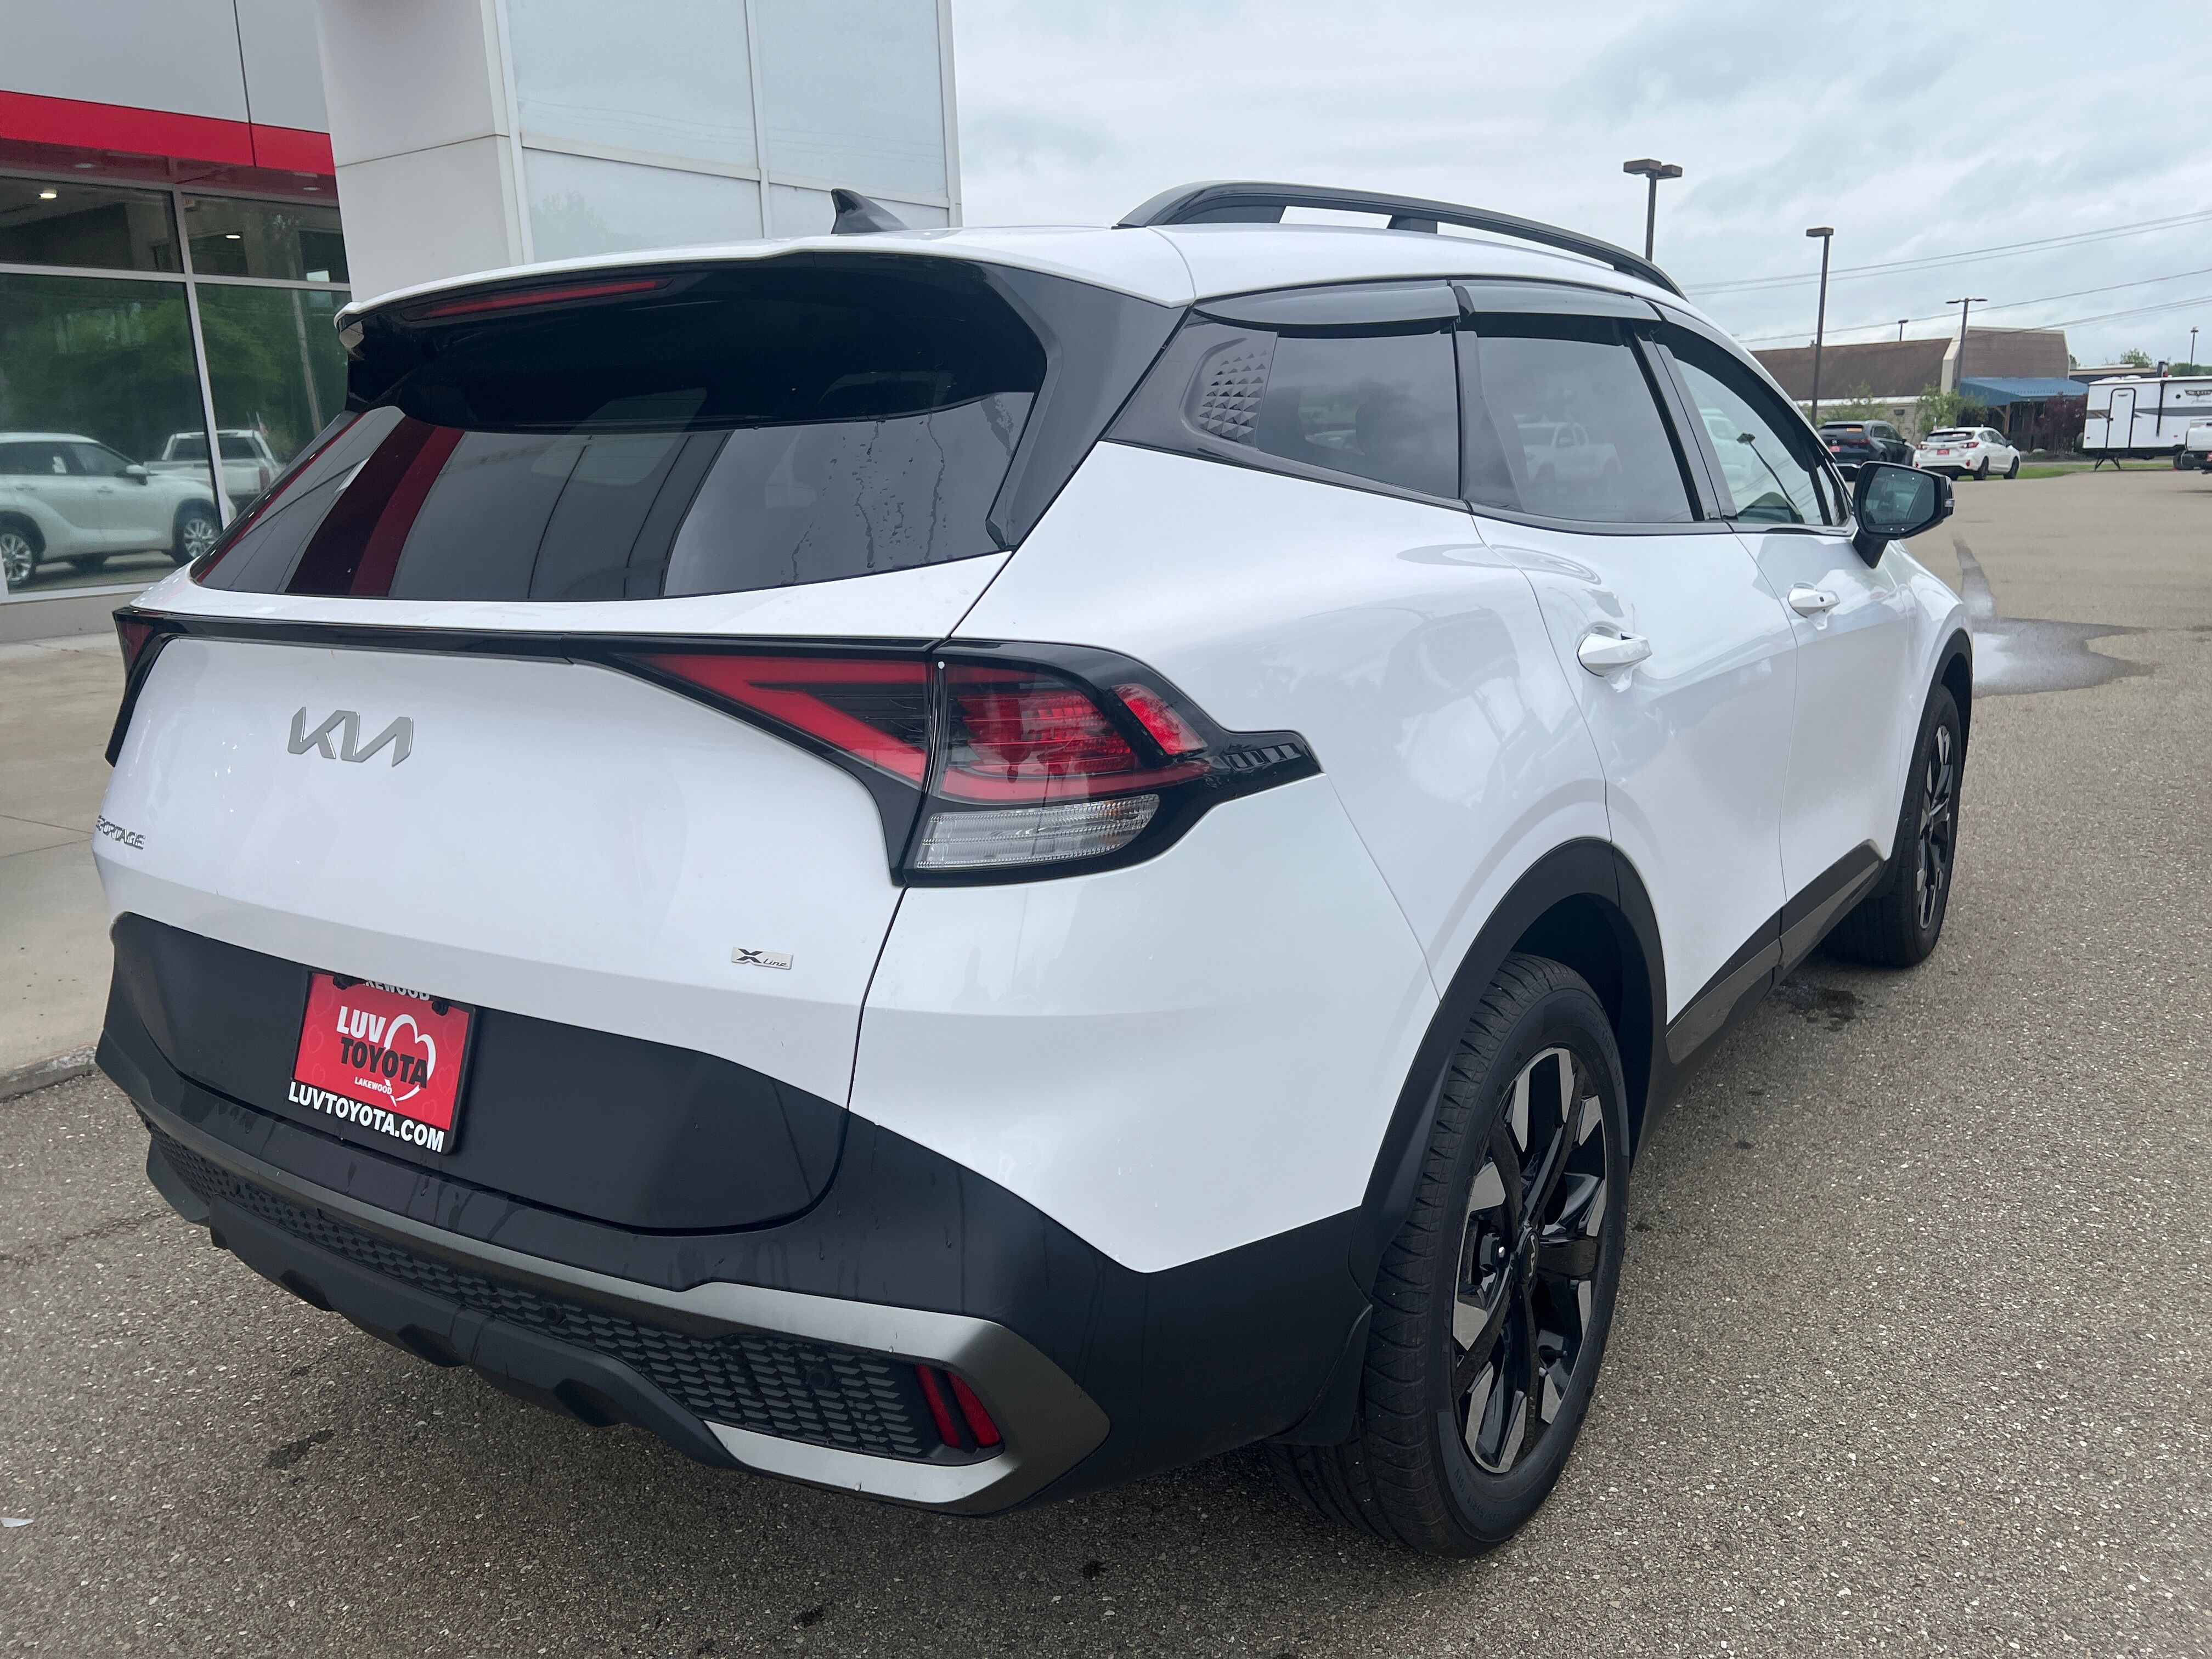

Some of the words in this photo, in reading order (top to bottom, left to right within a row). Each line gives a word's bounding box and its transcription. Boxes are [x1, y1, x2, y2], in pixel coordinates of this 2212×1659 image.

[287, 706, 414, 767] KIA
[336, 1006, 386, 1043] LUV
[341, 1036, 427, 1088] TOYOTA
[354, 1076, 393, 1095] LAKEWOOD
[288, 1081, 444, 1153] LUVTOYOTA.COM
